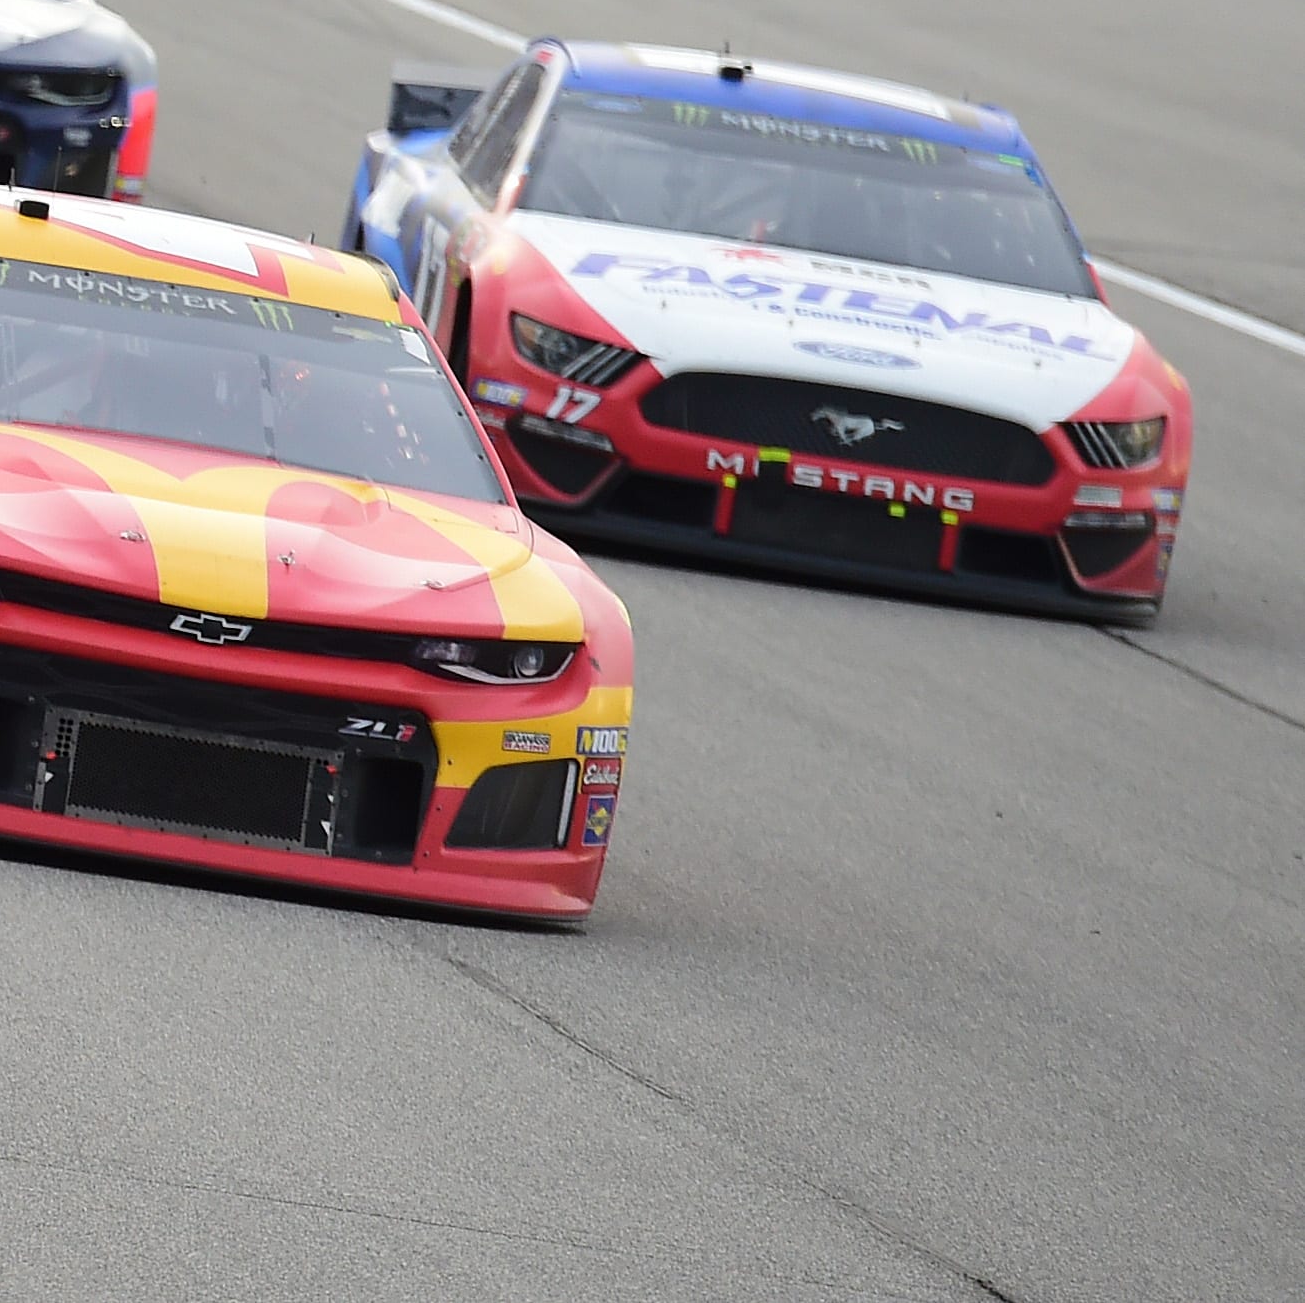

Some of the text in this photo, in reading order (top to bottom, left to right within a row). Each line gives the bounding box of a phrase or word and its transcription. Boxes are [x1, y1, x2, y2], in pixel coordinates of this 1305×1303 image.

[720, 110, 891, 153] MONSTER
[27, 269, 238, 316] MONSTER
[793, 306, 936, 339] Constructio
[544, 385, 602, 424] 17
[706, 448, 975, 512] MSTANG
[338, 716, 418, 742] ZL1
